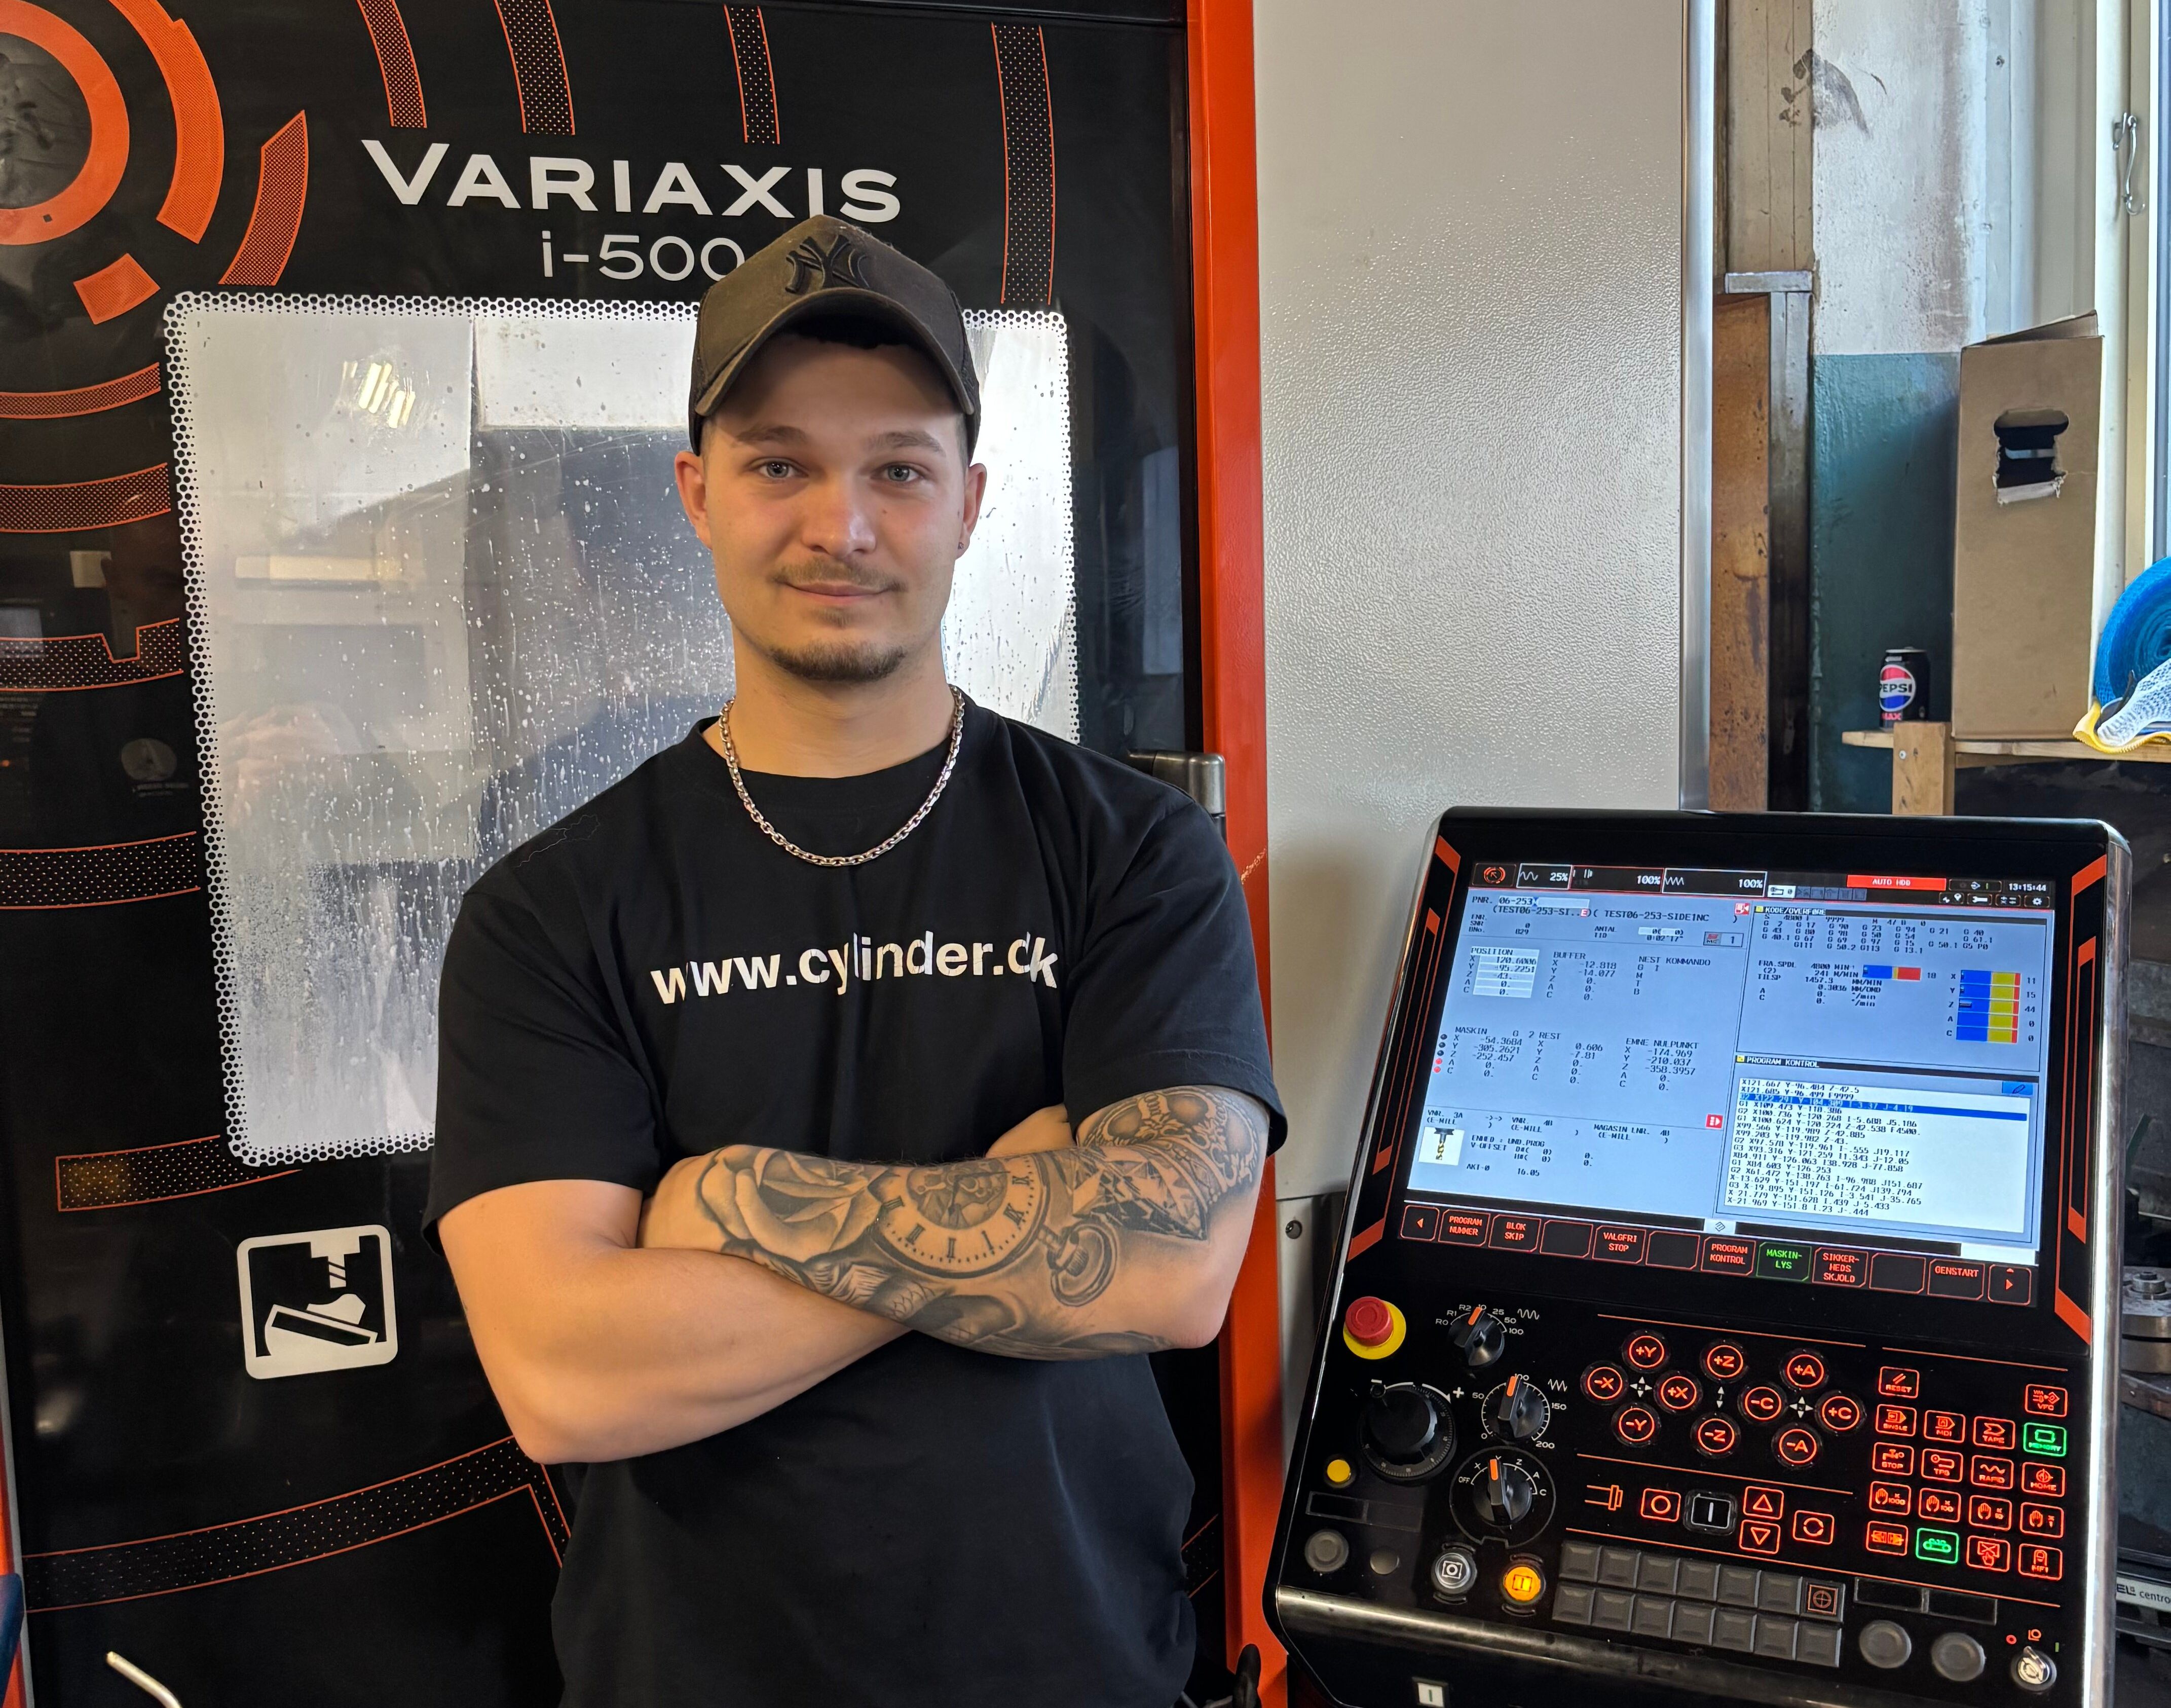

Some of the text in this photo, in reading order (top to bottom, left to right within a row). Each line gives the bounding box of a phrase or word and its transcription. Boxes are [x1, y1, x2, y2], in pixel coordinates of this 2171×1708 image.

[360, 138, 901, 222] VARIAXIS
[542, 230, 745, 282] i-500
[1550, 872, 1568, 882] 25%
[1637, 875, 1661, 885] 100%
[1739, 879, 1763, 888] 100%
[2009, 883, 2046, 892] 13:15:44
[1499, 897, 1533, 905] 06-253
[1471, 947, 1513, 955] POSITION
[1553, 951, 1586, 959] BUFFER
[1666, 957, 1711, 966] KOMMANDO
[650, 930, 1059, 1005] www.cylinder.dk
[1455, 1026, 1561, 1039] MASKIN REST
[1626, 1038, 1699, 1049] EMNE NULPUNKT
[1648, 1048, 1693, 1058] -174.969
[1647, 1056, 1691, 1066] -210.037
[1746, 1057, 1819, 1068] PROGRAM KONTROL
[1645, 1065, 1696, 1075] -358.3957
[1594, 1124, 1628, 1132] MAGASIN
[1449, 1215, 1483, 1227] PROGRAM
[1506, 1221, 1526, 1231] BLOK
[1449, 1226, 1478, 1236] NUMMER
[1504, 1232, 1524, 1241] SKIP
[1603, 1232, 1637, 1243] VALGFRI
[1608, 1243, 1629, 1252] STOP
[1711, 1243, 1748, 1254] PROGRAM
[1767, 1248, 1803, 1260] MASKIN-
[1822, 1252, 1860, 1263] SIKKER-
[1710, 1254, 1746, 1265] KONTROL
[1775, 1260, 1792, 1270] LYS
[1828, 1263, 1852, 1273] HEDS
[1934, 1265, 1979, 1278] GENSTART
[1823, 1272, 1856, 1283] SKJOLD
[1509, 1327, 1524, 1335] 100
[1636, 1345, 1657, 1358] +Y
[1713, 1355, 1735, 1368] +Z
[1793, 1364, 1816, 1378] +A
[1594, 1377, 1615, 1390] -X
[1885, 1384, 1912, 1393] RESET
[1667, 1386, 1689, 1400] +X
[1551, 1402, 1567, 1410] 150
[1751, 1397, 1774, 1410] -C
[1828, 1406, 1852, 1420] +C
[1625, 1418, 1648, 1432] -Y
[1883, 1423, 1908, 1431] SINGLE
[1704, 1430, 1726, 1442] -Z
[1982, 1435, 2005, 1443] TAPE
[1536, 1440, 1555, 1449] 200
[1786, 1440, 1809, 1453] -A
[2029, 1442, 2062, 1452] MEMORY
[1458, 1476, 1470, 1484] OFF
[1979, 1474, 2005, 1483] RAPID
[2030, 1481, 2056, 1491] HOME
[1888, 1497, 1906, 1505] 1000
